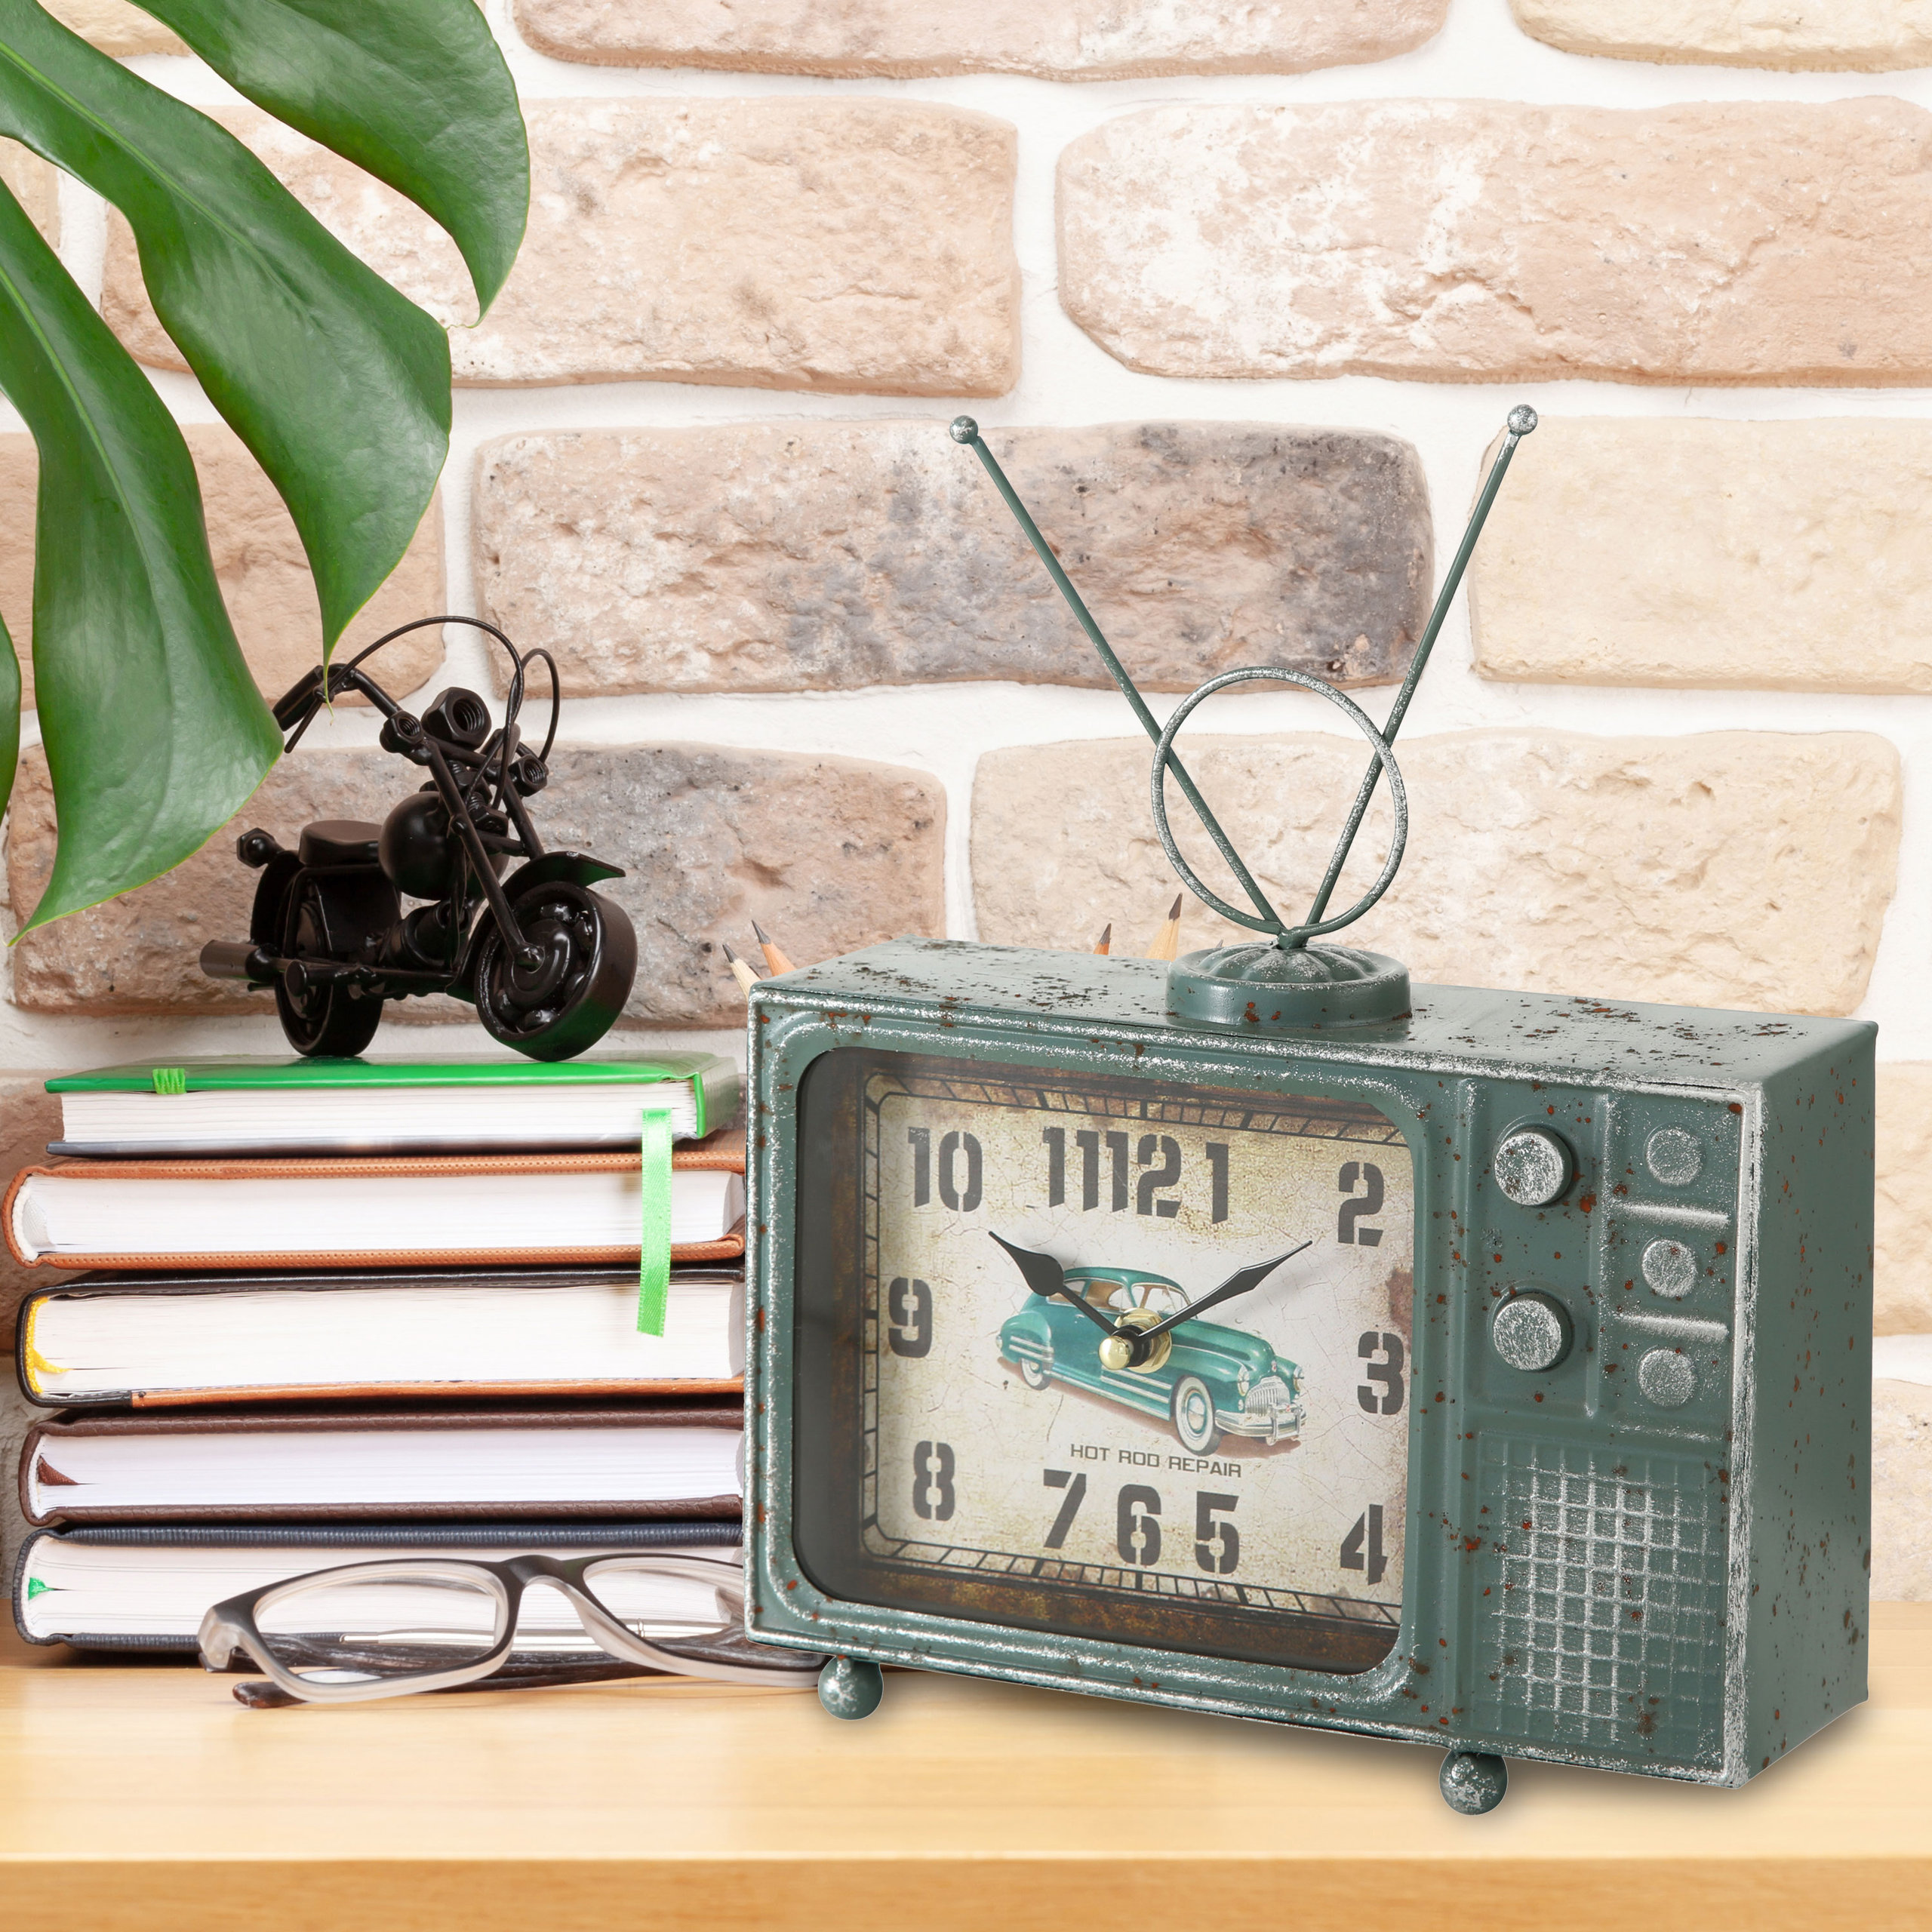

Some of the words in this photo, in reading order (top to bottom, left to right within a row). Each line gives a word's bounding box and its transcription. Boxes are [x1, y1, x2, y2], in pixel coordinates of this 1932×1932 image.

[908, 1128, 983, 1212] 10
[1207, 1143, 1229, 1224] 1
[1338, 1161, 1384, 1247] 2
[888, 1278, 933, 1358] 9
[1358, 1331, 1404, 1415] 3
[912, 1441, 955, 1521] 8
[1070, 1444, 1110, 1462] HOT
[1118, 1449, 1160, 1467] ROD
[1168, 1456, 1242, 1478] REPAIR
[1043, 1469, 1087, 1549] 7
[1117, 1484, 1162, 1567] 6
[1195, 1491, 1239, 1574] 5
[1340, 1504, 1388, 1585] 4
